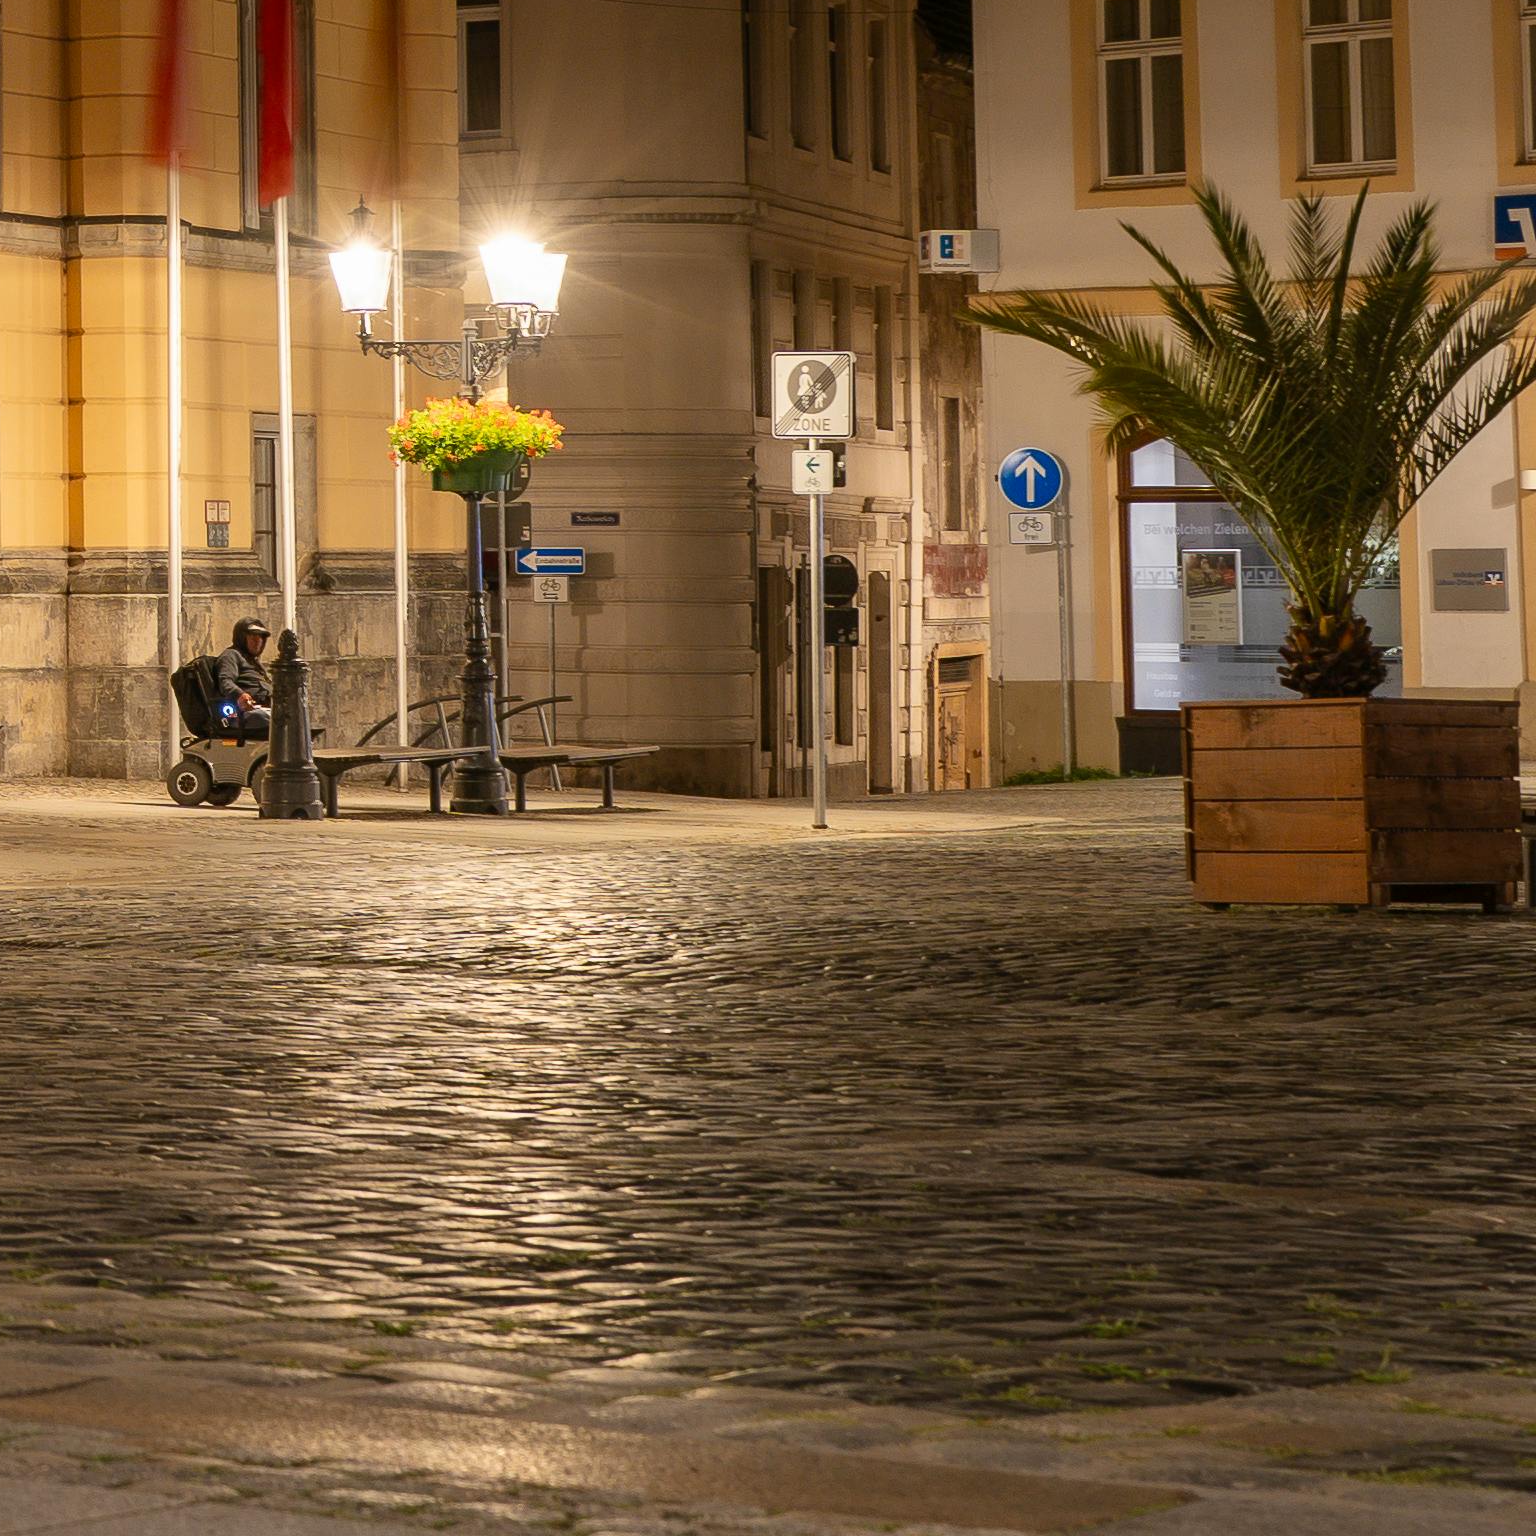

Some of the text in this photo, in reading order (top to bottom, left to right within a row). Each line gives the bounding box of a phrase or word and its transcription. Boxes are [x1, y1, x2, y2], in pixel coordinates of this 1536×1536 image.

[793, 418, 832, 432] ZONE
[1143, 523, 1161, 535] Bei
[1163, 523, 1211, 535] welchen
[1214, 523, 1248, 535] Zielen
